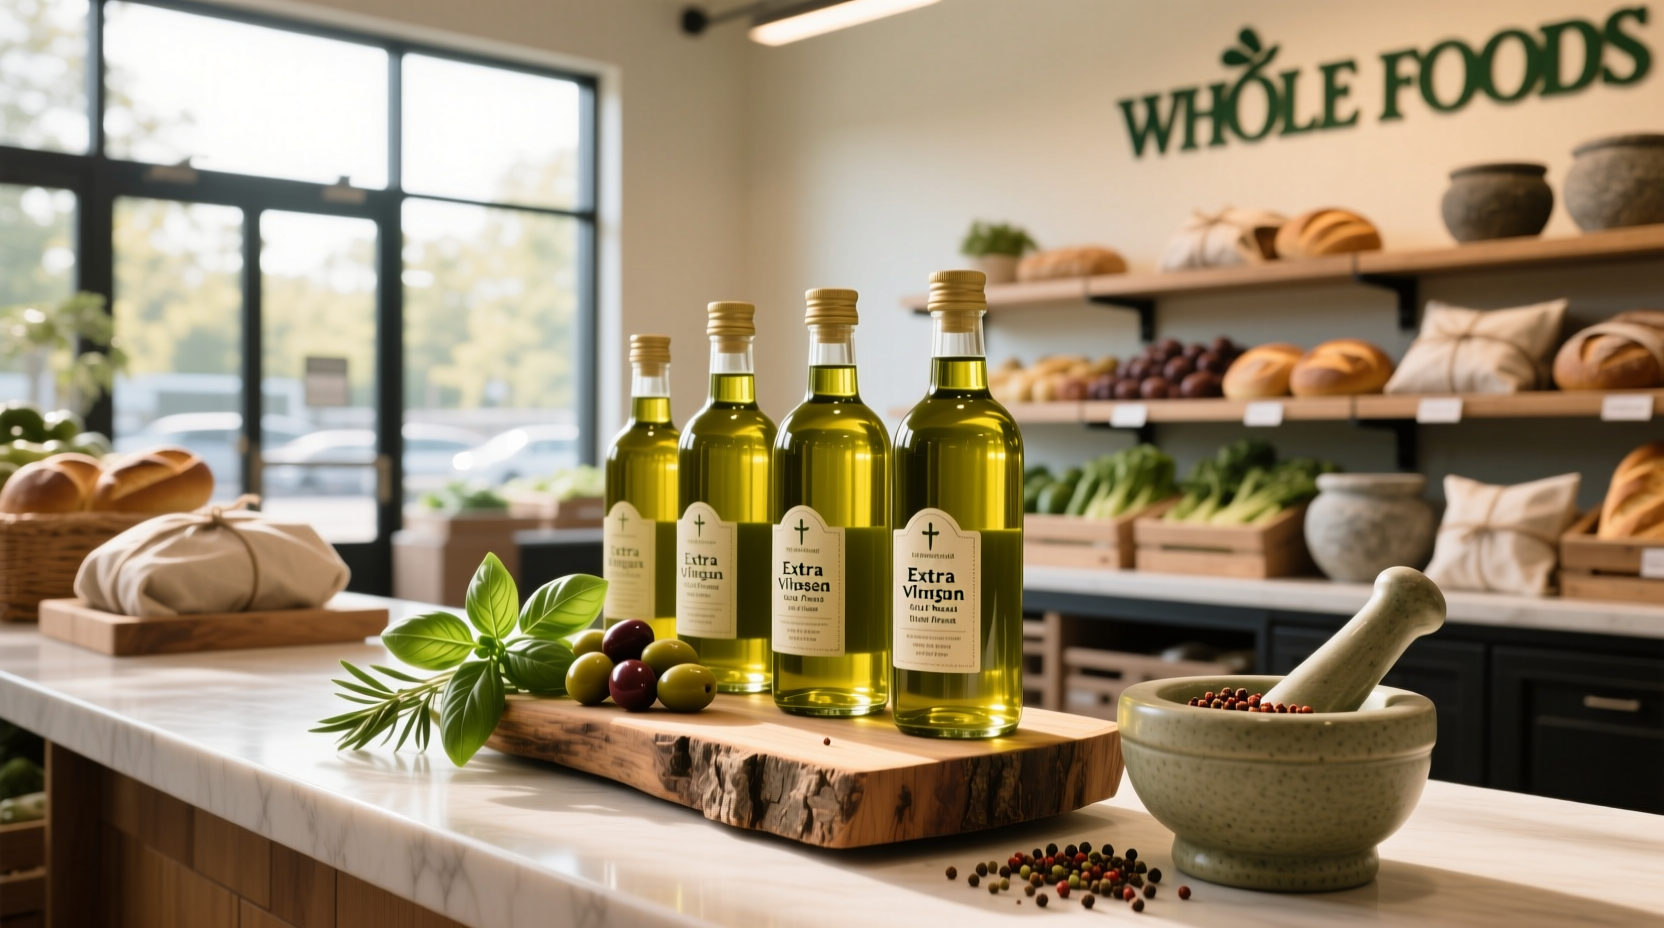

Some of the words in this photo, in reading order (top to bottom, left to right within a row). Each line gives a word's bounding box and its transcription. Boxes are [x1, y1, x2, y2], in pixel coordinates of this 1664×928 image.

[1118, 58, 1360, 157] WHOLE
[1378, 7, 1652, 121] FOODS
[685, 552, 718, 566] Extra
[782, 561, 823, 576] Extra
[908, 567, 955, 583] Extra
